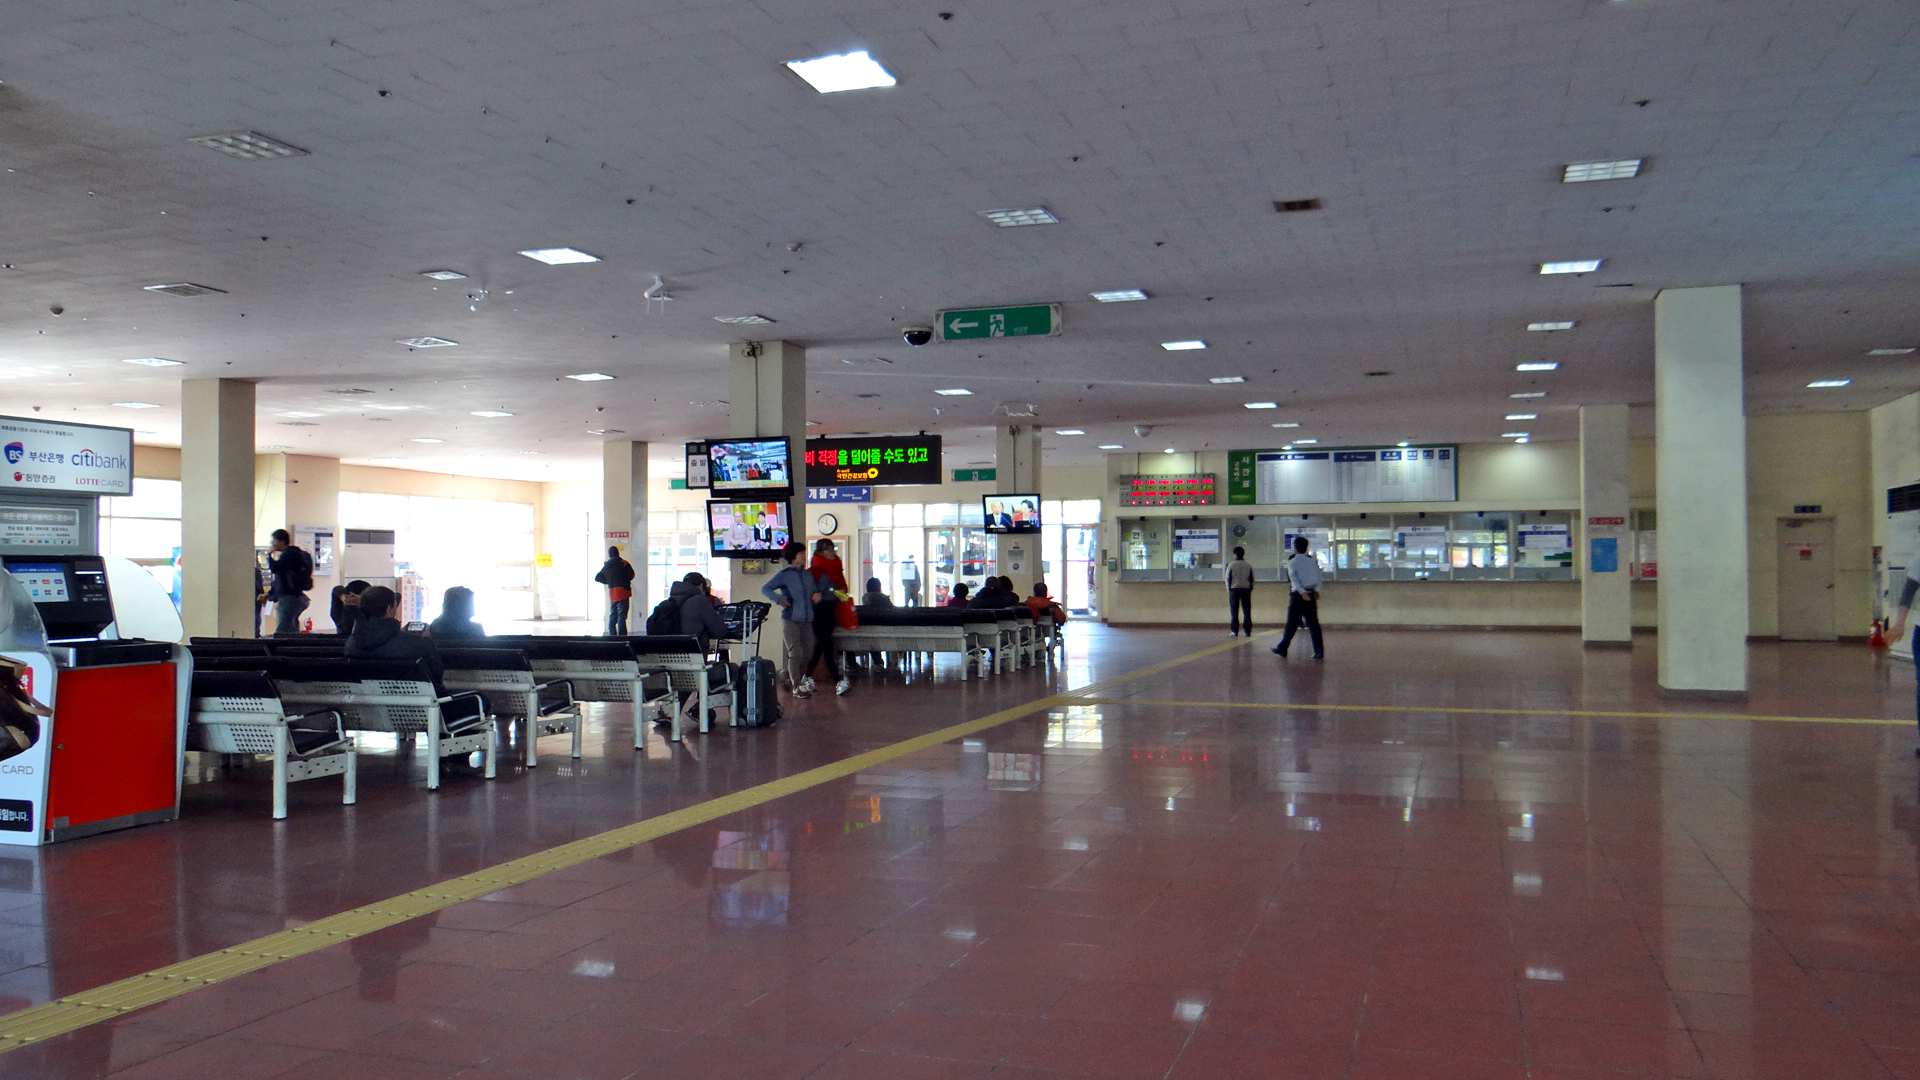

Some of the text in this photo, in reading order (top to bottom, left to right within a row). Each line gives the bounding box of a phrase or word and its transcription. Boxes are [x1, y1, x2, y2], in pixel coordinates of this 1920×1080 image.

[9, 450, 22, 460] BS
[29, 452, 64, 464] 부산은행
[71, 449, 127, 469] citibank
[818, 449, 848, 466] 걱정을
[851, 448, 881, 465] 덜어줄
[883, 448, 904, 464] 수도
[907, 447, 928, 464] 있고
[25, 473, 56, 483] 동양증권
[836, 472, 868, 480] 국민건강보험
[75, 477, 124, 487] LOTTE CARD
[808, 488, 838, 499] 개찰구
[1, 764, 34, 775] CARD
